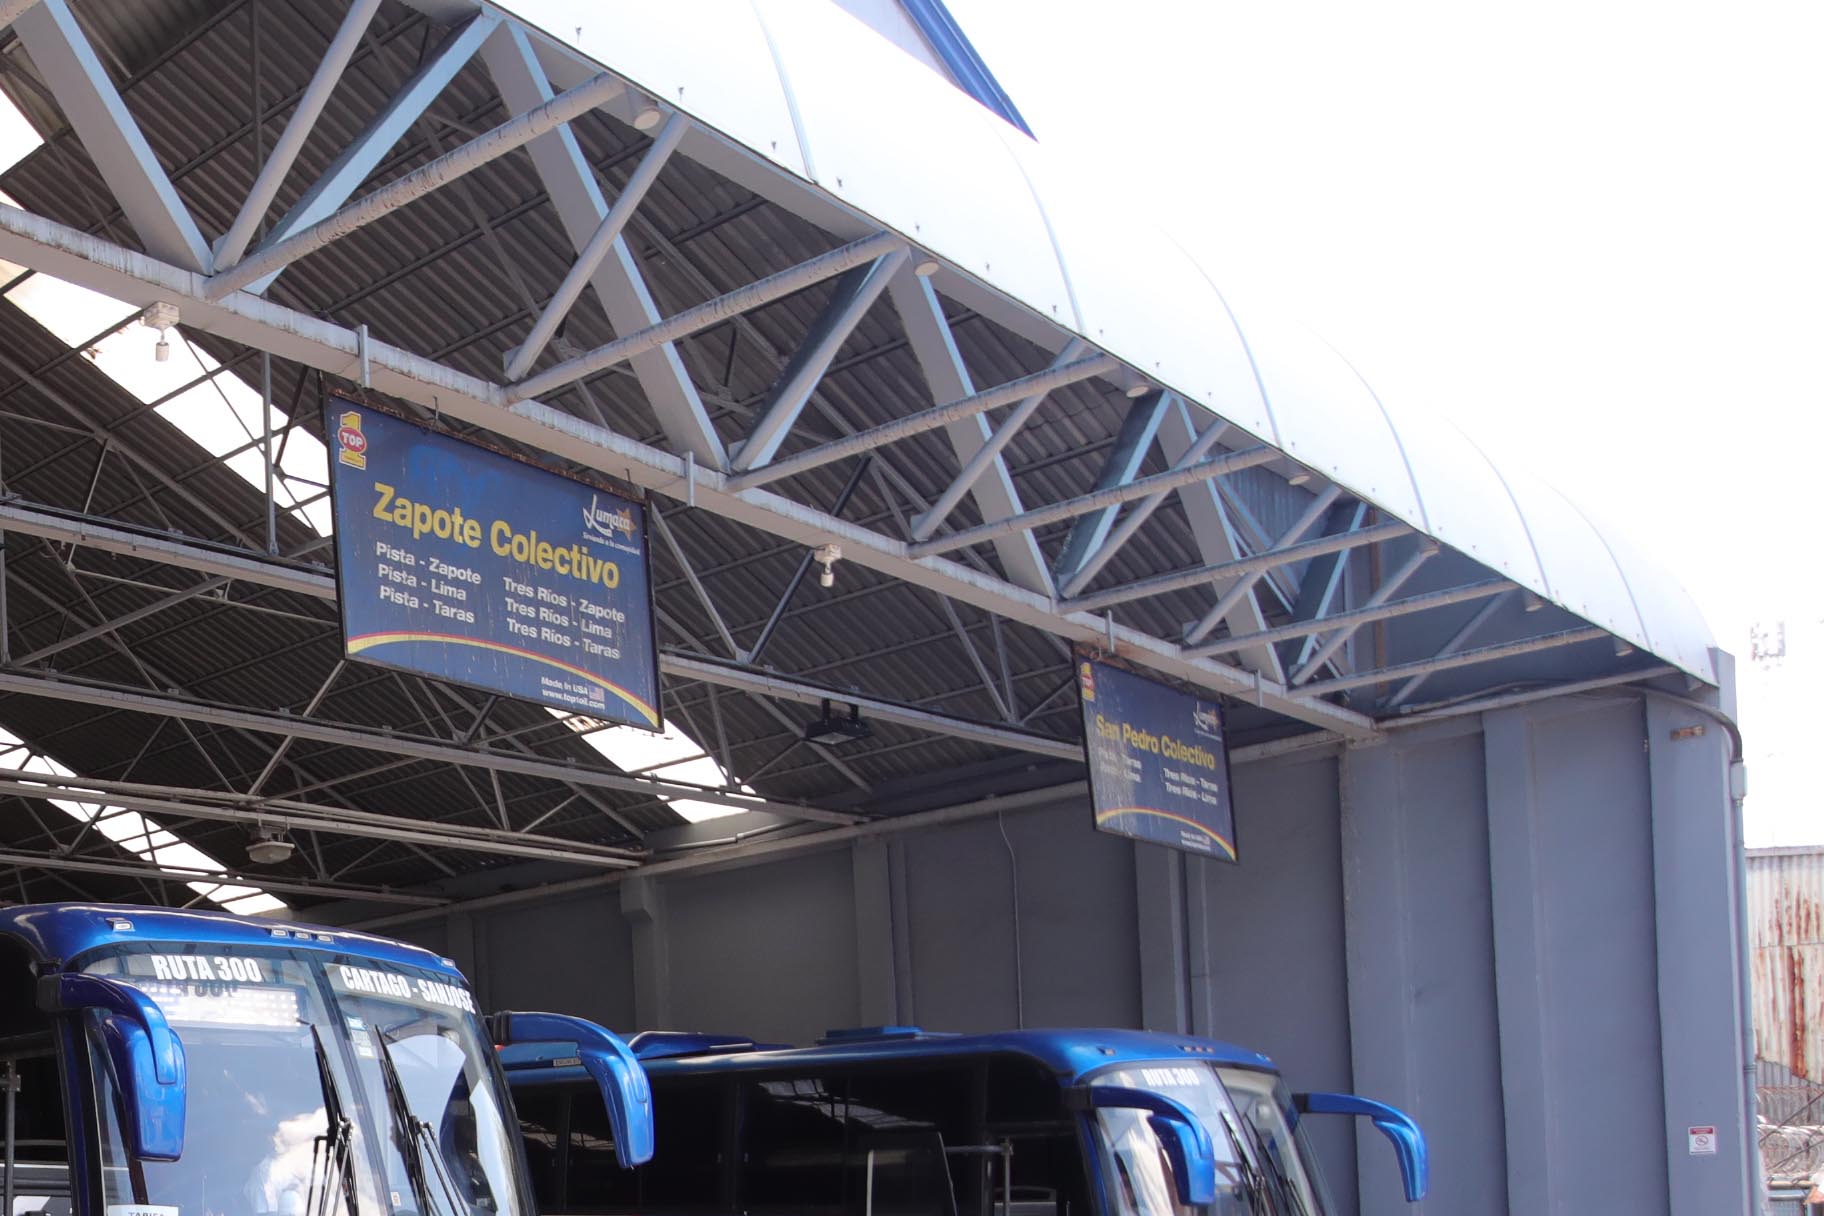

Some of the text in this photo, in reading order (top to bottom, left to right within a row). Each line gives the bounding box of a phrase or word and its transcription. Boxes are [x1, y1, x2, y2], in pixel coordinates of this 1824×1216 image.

[341, 431, 363, 448] TOP
[373, 482, 620, 589] Zapote Colectivo
[376, 541, 416, 566] Pista
[429, 557, 481, 584] Zapote
[378, 563, 417, 587] Pista
[431, 578, 466, 600] Lima
[380, 585, 418, 608] Pista
[433, 599, 475, 624] Taras
[503, 576, 534, 598] Tres
[579, 598, 625, 622] Zapote
[505, 597, 536, 618] Tres
[581, 619, 612, 638] Lima
[507, 617, 538, 638] Tres
[582, 638, 621, 659] Taras
[1096, 714, 1121, 741] San
[1122, 722, 1159, 754] Pedro
[1160, 735, 1216, 770] Colectivo
[151, 954, 263, 983] RUTA 300
[339, 965, 413, 1000] CARTAGO
[1140, 1067, 1200, 1087] RUTA 300
